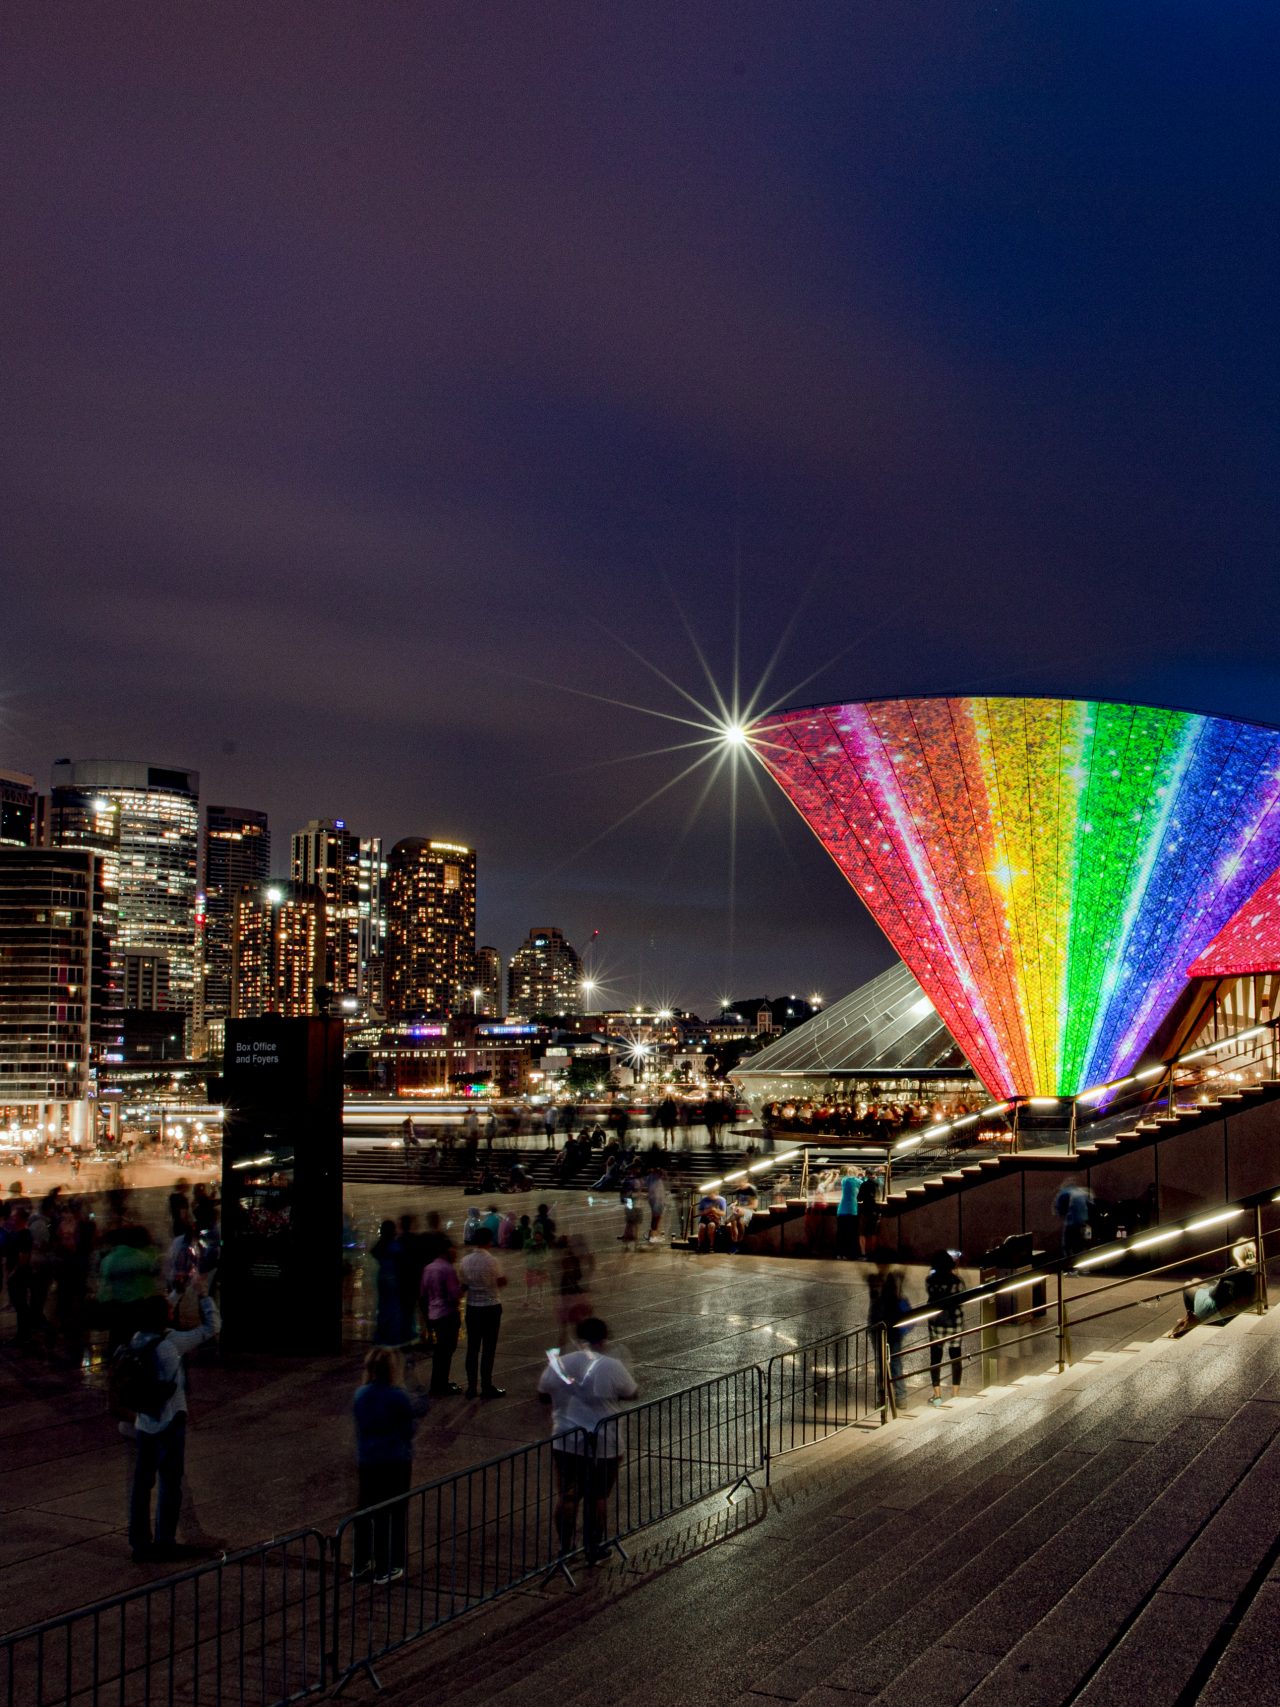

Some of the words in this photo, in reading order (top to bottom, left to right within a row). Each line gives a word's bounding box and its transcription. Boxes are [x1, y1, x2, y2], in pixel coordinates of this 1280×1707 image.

[236, 1042, 251, 1052] Box
[253, 1042, 277, 1052] Office
[235, 1054, 250, 1064] and
[252, 1054, 279, 1066] Foyers
